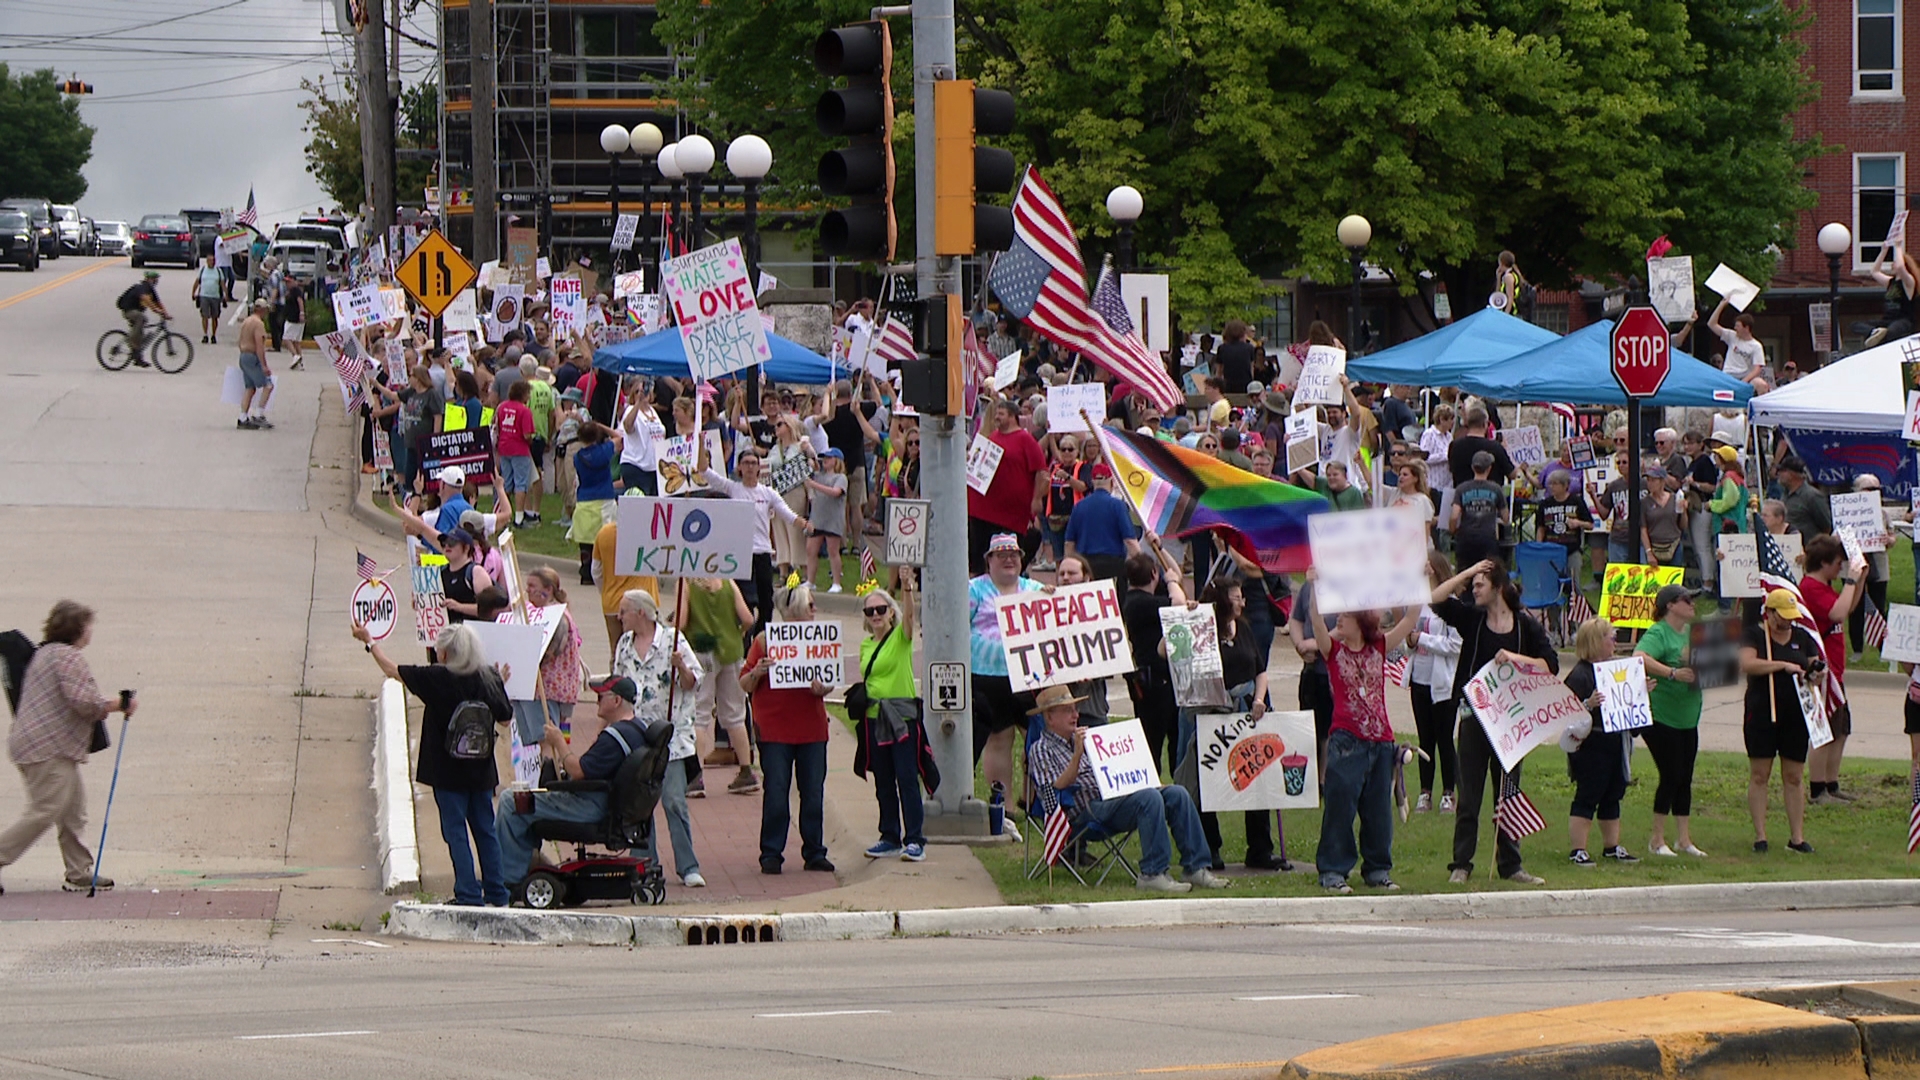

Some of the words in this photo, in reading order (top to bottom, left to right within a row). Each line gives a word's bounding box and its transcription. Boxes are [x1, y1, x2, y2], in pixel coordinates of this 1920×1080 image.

[680, 260, 725, 290] HATE
[352, 290, 363, 298] NO
[553, 280, 581, 293] HATE
[350, 296, 371, 308] KINGS
[675, 277, 754, 326] LOVE
[352, 313, 380, 327] QUEENS
[326, 332, 344, 346] NO
[690, 314, 751, 355] DANCE
[696, 334, 756, 381] PARTY
[1617, 336, 1665, 368] STOP
[431, 432, 475, 448] DICTATOR
[448, 446, 461, 457] OR
[429, 461, 485, 480] DERACY
[1831, 494, 1868, 505] Schools
[651, 502, 711, 542] NO
[894, 506, 921, 519] NO
[1833, 507, 1874, 518] Libraries
[634, 545, 738, 575] KINGS
[888, 536, 922, 564] King!
[356, 600, 393, 621] TRUMP
[1001, 588, 1120, 637] IMPEACH
[427, 628, 439, 641] YO
[770, 624, 838, 641] MEDICAID
[768, 645, 798, 660] CUTS
[806, 643, 842, 660] HURT
[1010, 628, 1123, 676] TRUMP
[775, 663, 841, 684] SENIORS!
[1484, 663, 1514, 693] NO
[1485, 693, 1510, 724] DUE
[1509, 675, 1562, 700] PROCESS
[1611, 682, 1633, 709] NO
[1609, 703, 1648, 731] KINGS
[1091, 734, 1134, 761] Resist
[1240, 743, 1257, 761] NO
[1238, 744, 1274, 779] TACO
[1284, 767, 1299, 781] NO
